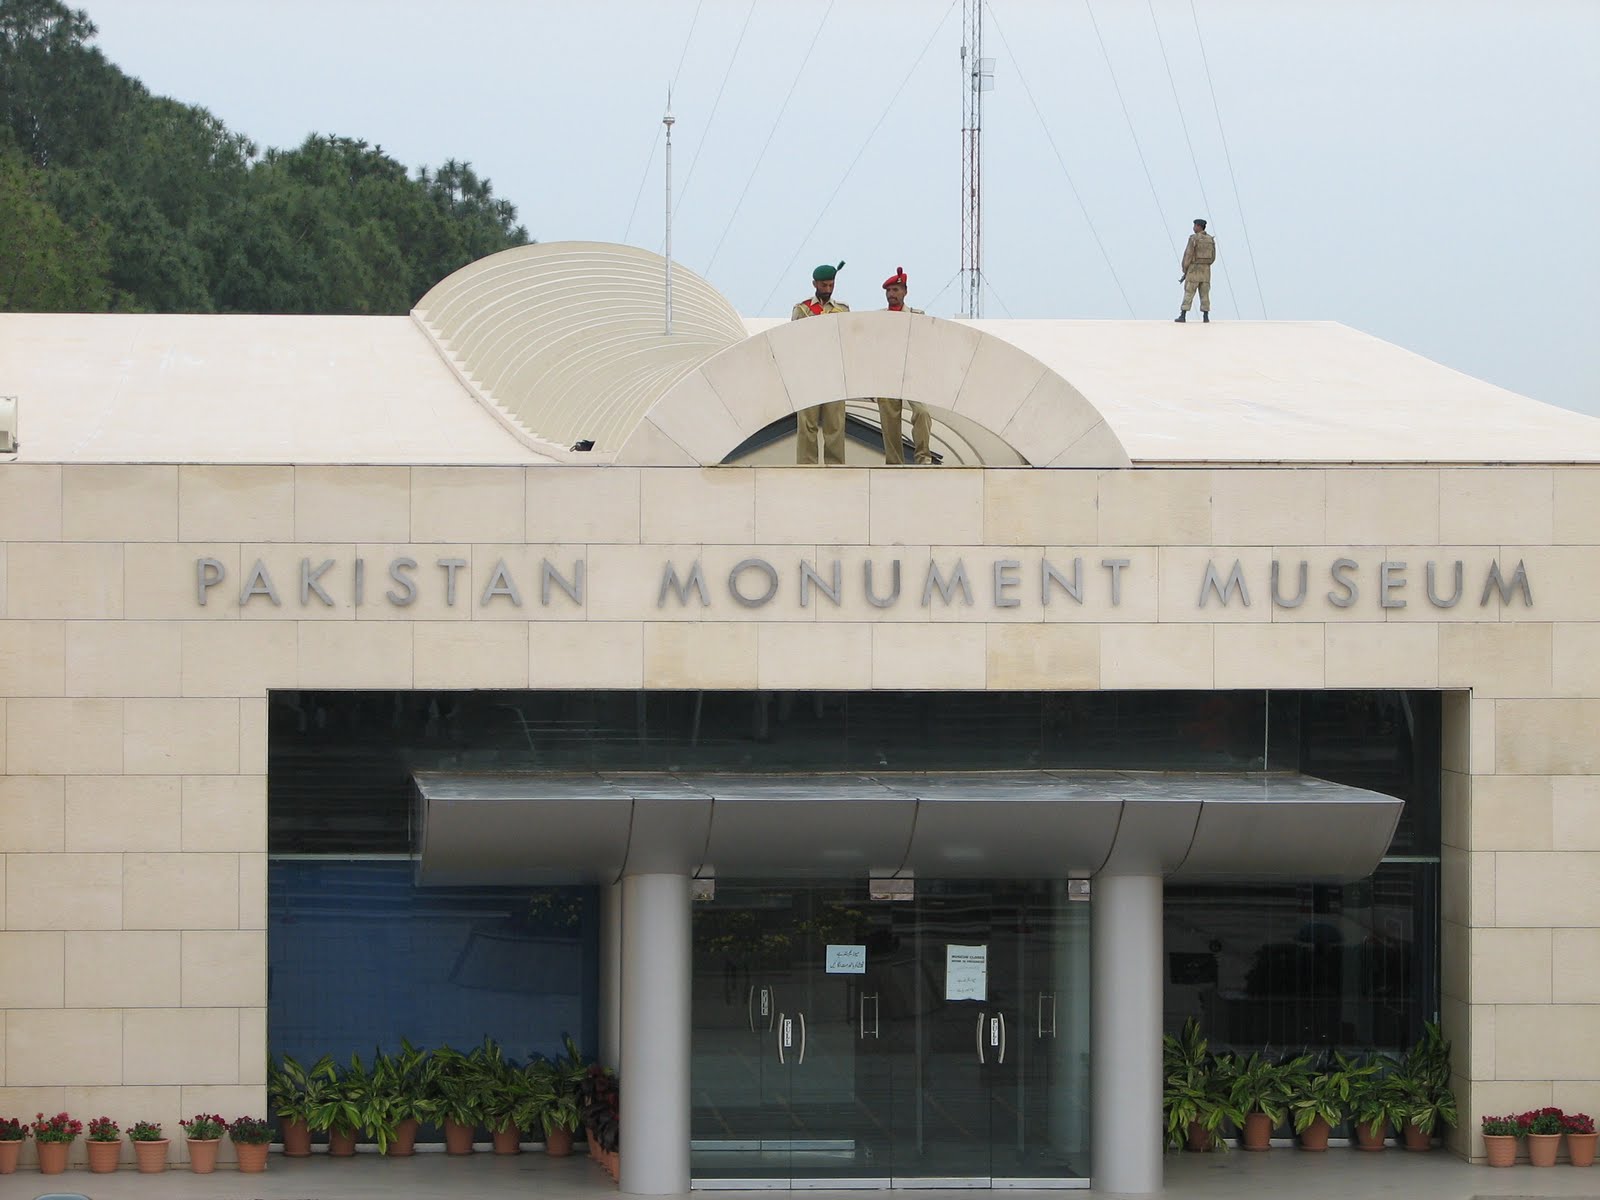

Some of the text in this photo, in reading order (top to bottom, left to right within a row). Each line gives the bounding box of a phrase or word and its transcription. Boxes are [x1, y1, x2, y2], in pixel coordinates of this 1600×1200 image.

[196, 557, 1533, 610] PAKISTAN MONUMENT MUSEUM
